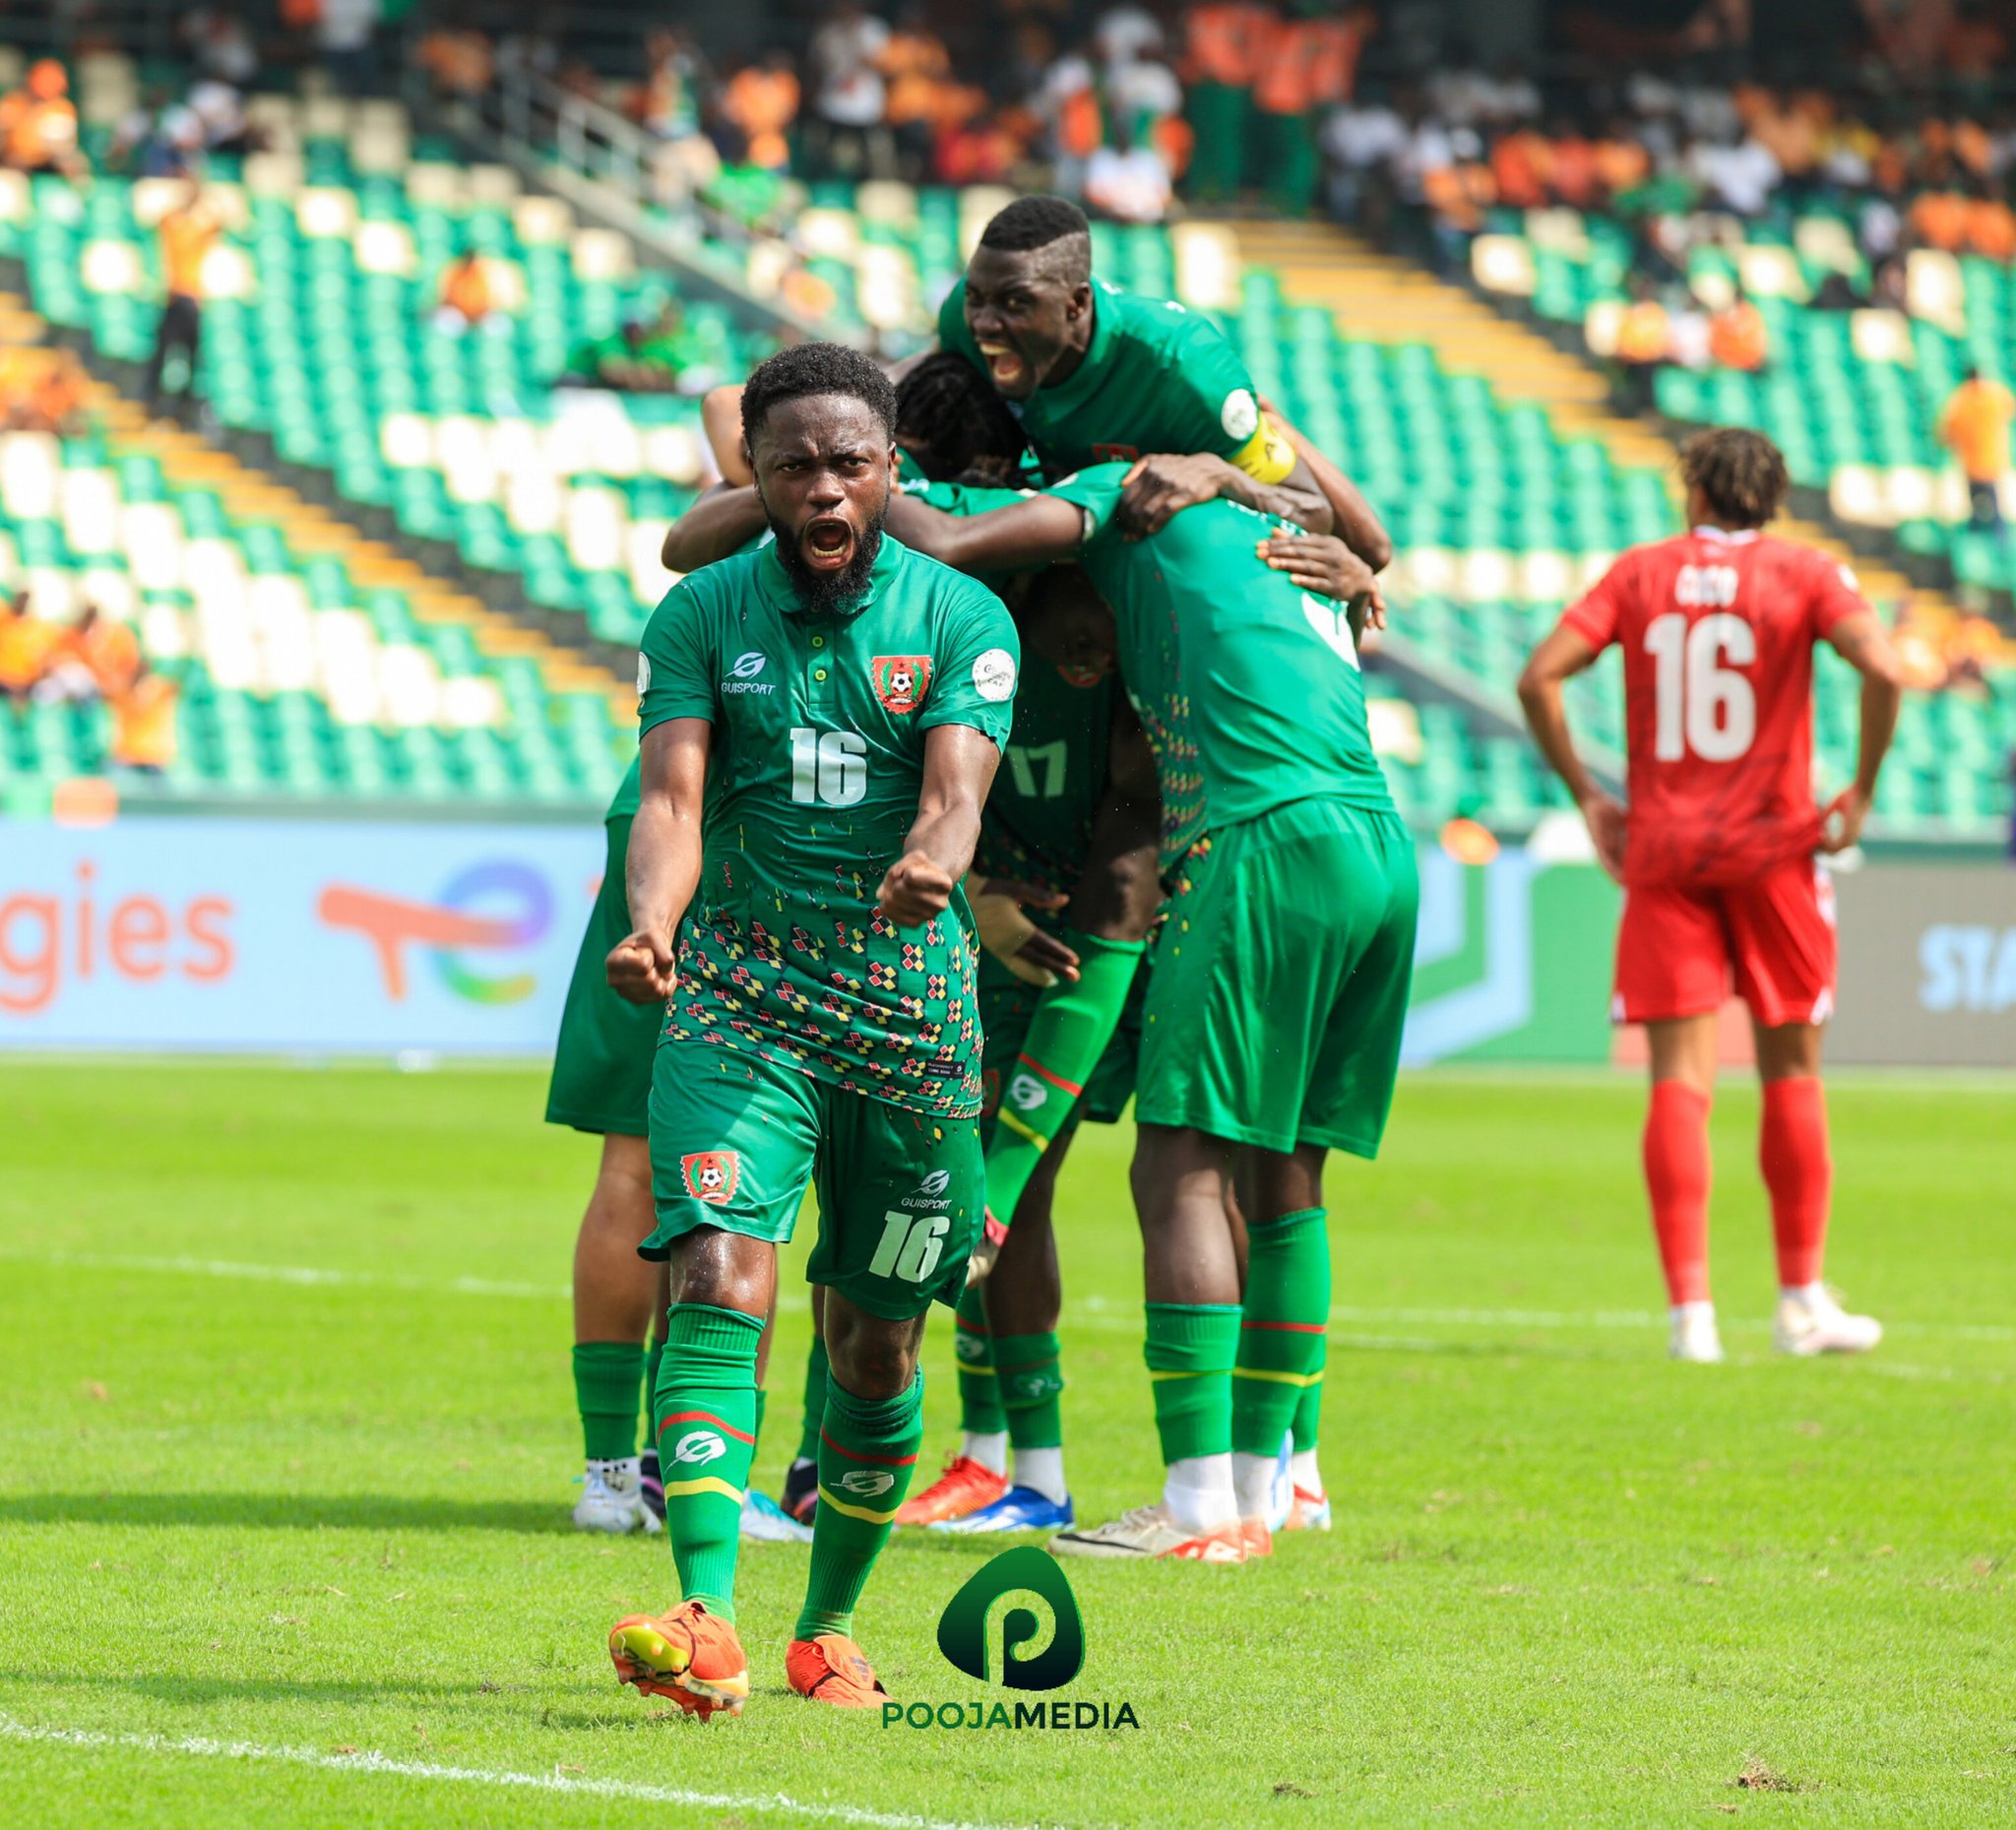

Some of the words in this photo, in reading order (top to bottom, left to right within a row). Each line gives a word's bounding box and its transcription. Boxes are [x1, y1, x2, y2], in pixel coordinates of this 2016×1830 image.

[721, 681, 777, 696] GUISPORT
[1643, 612, 1756, 763] 16
[789, 726, 867, 806] 16
[1006, 739, 1068, 798] 17
[901, 1197, 953, 1210] GUISPORT
[868, 1210, 951, 1284] 16
